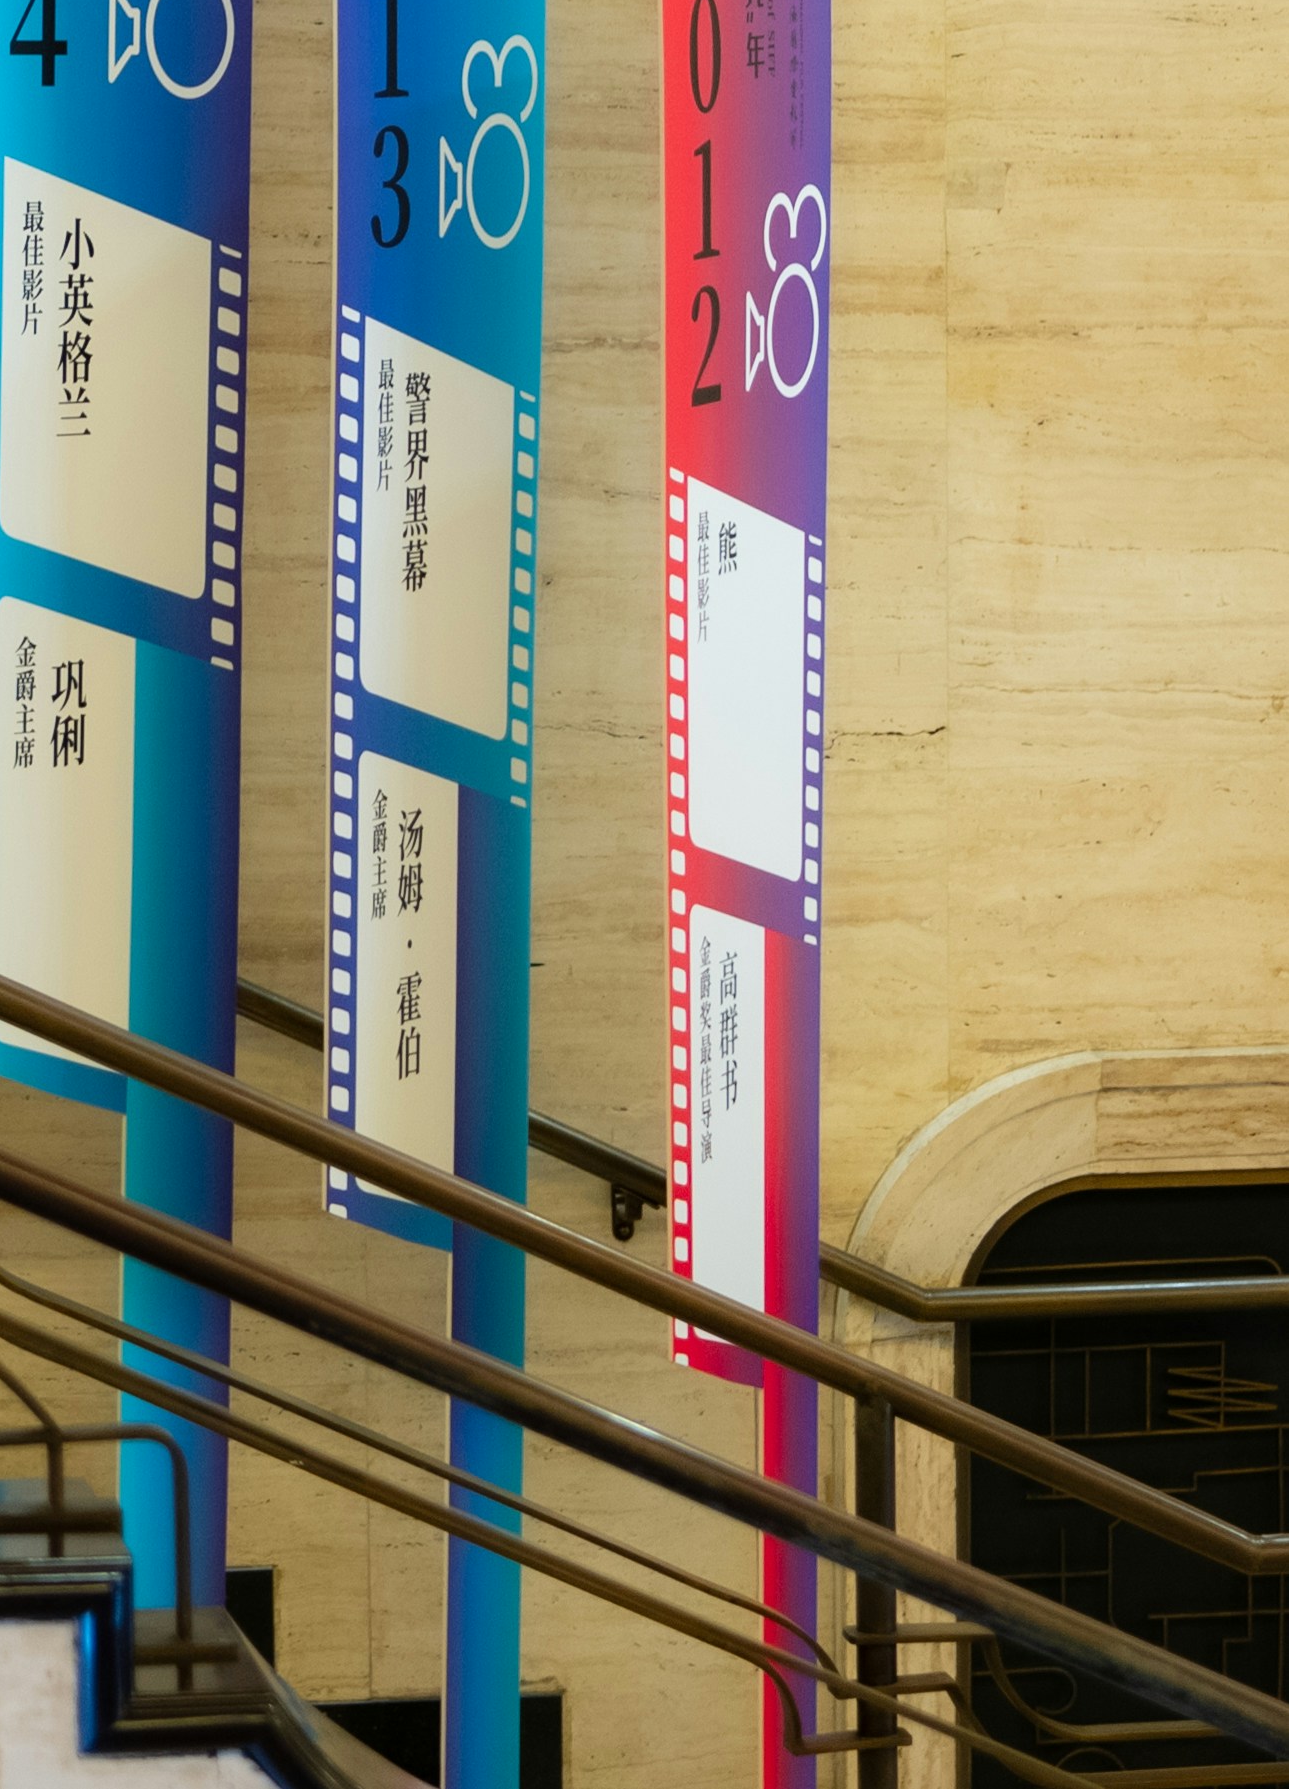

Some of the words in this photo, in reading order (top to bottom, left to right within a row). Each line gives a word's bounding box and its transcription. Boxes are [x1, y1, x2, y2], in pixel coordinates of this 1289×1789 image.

[767, 30, 776, 77] SIFF
[20, 201, 44, 336] 最佳影片
[55, 217, 95, 437] 小英格兰
[376, 358, 394, 492] 最佳影片
[402, 371, 431, 592] 警界黑幕
[697, 511, 710, 645] 最佳影片
[718, 521, 738, 575] 熊
[13, 636, 37, 770] 金爵主席
[50, 658, 88, 770] 巩俐
[371, 788, 388, 921] 金爵主席
[396, 807, 424, 1080] 汤姆·霍伯
[700, 936, 712, 1164] 金爵奖最佳导演
[719, 951, 738, 1111] 高群书
